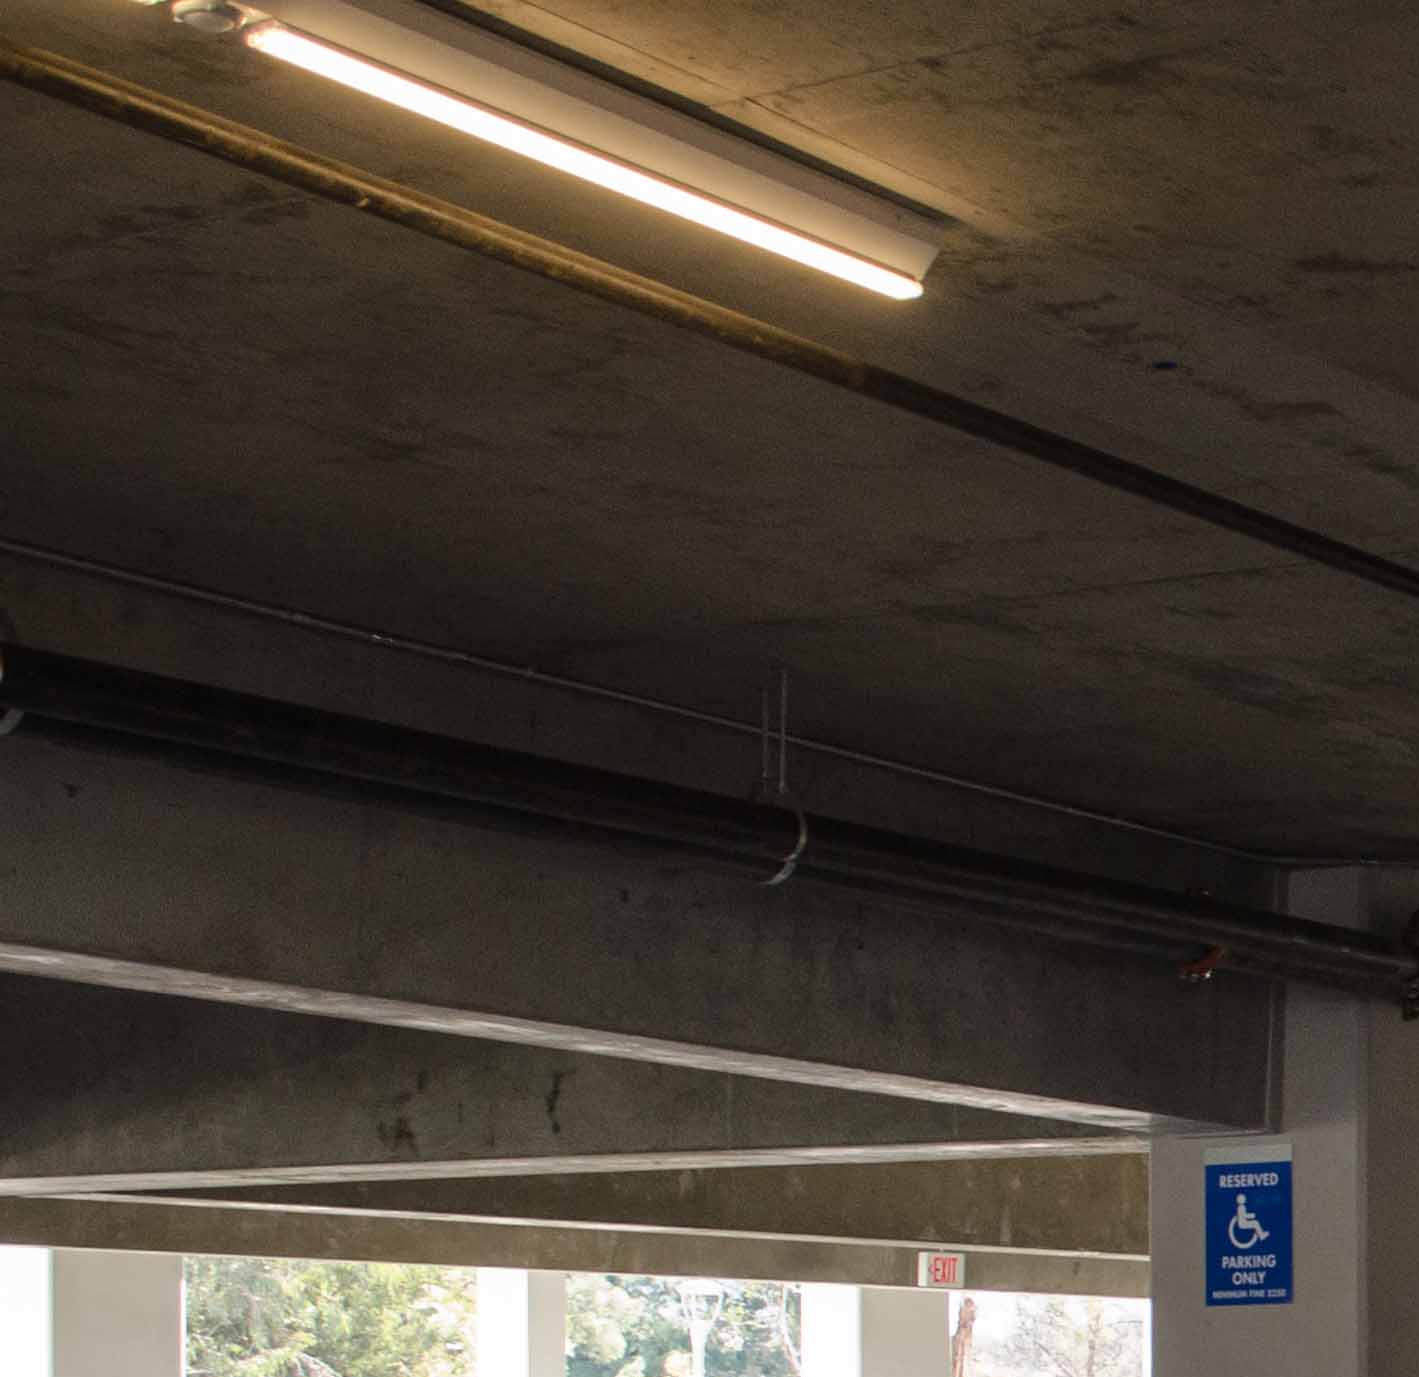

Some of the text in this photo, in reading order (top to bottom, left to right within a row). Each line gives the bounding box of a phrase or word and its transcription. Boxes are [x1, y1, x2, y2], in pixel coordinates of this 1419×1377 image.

[1219, 1172, 1279, 1188] RESERVED
[1221, 1254, 1276, 1269] PARKING
[1232, 1272, 1266, 1285] ONLY
